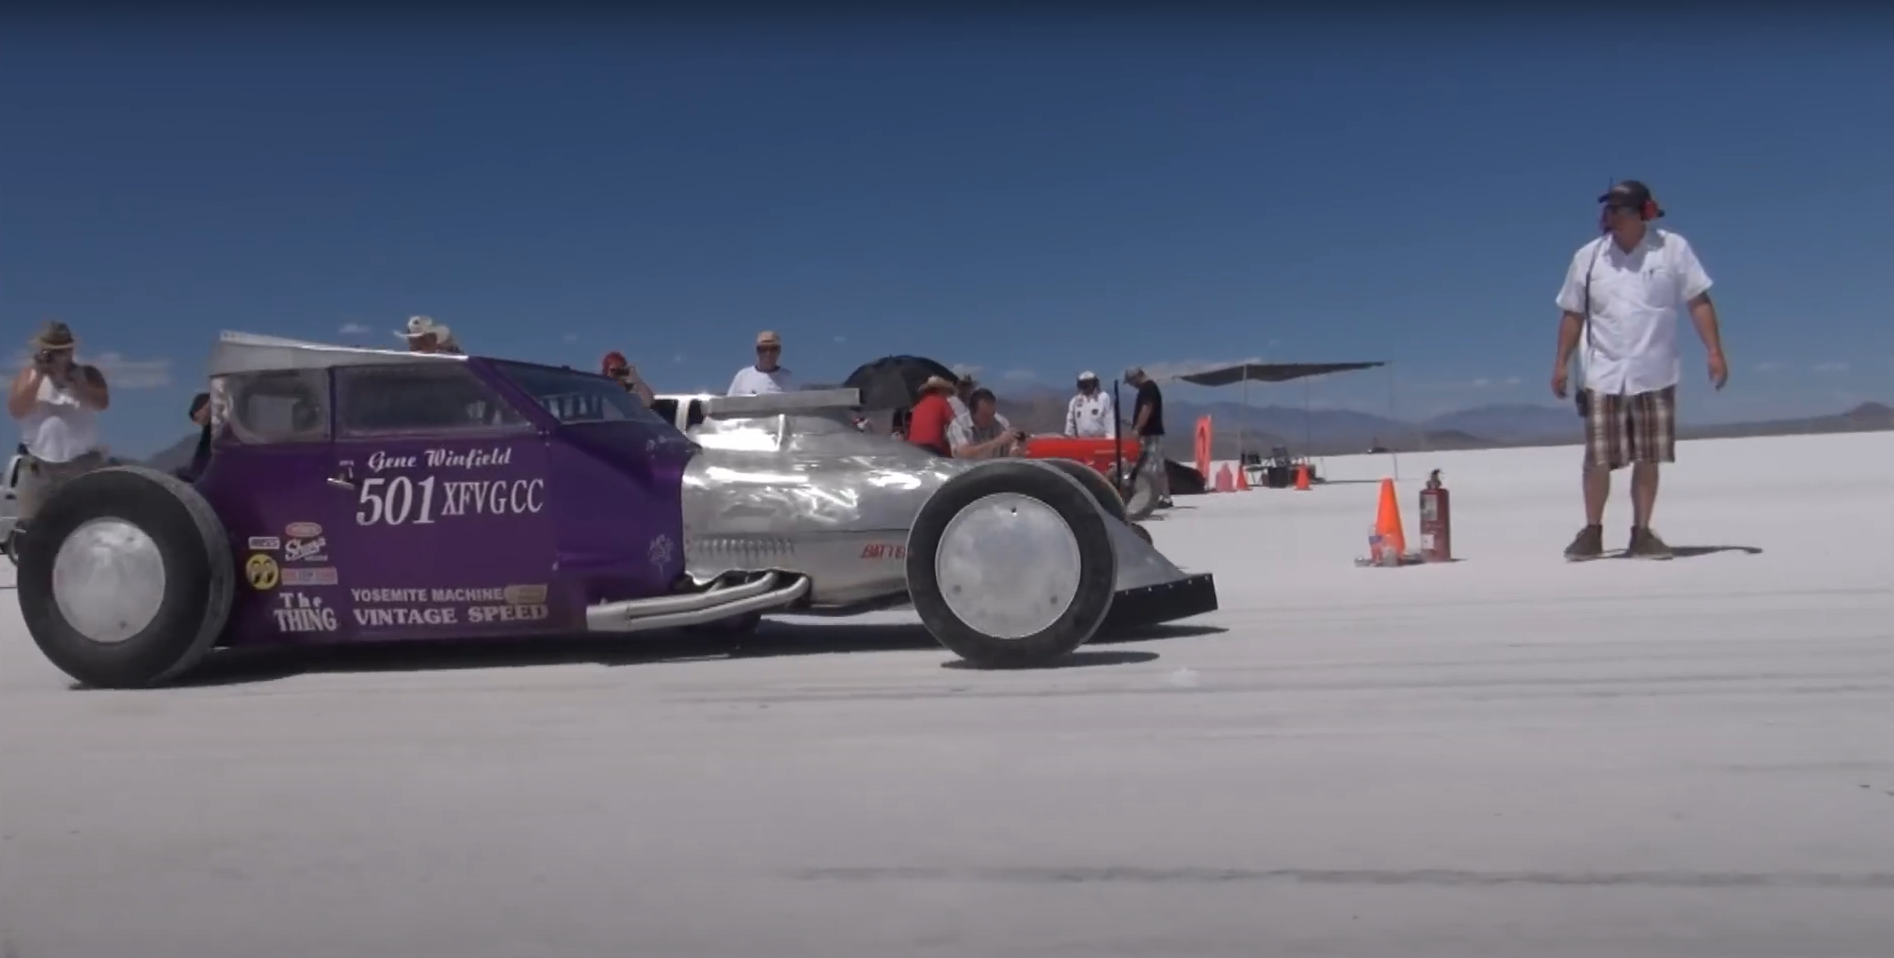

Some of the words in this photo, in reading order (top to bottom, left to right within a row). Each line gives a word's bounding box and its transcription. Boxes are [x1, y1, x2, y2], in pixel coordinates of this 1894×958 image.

[368, 451, 417, 473] Gene
[424, 447, 512, 469] Winfield
[356, 475, 436, 526] 501
[279, 592, 322, 608] The
[351, 588, 427, 602] YOSEMITE
[431, 588, 504, 602] MACHINE
[272, 607, 338, 632] THING
[353, 608, 458, 626] VINTAGE
[468, 605, 548, 622] SPEED
